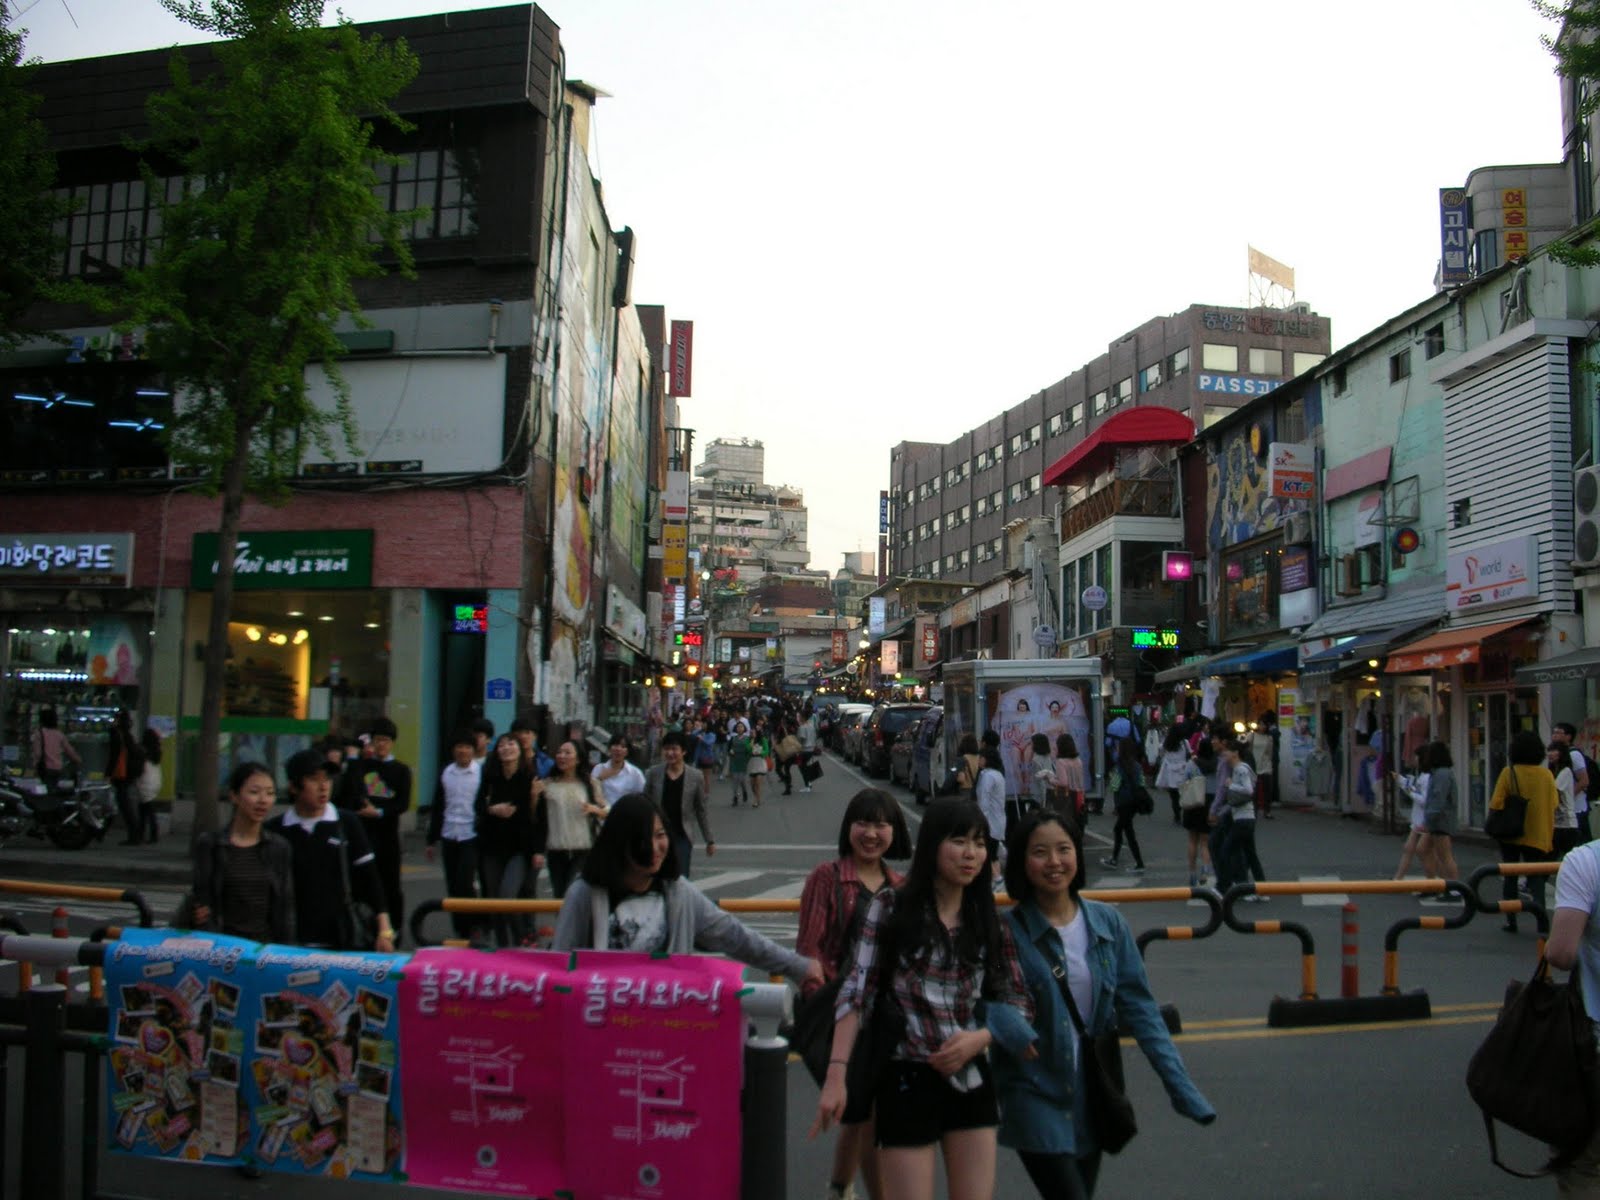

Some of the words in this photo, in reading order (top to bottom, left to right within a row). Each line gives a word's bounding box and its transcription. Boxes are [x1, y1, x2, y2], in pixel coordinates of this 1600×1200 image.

[1444, 211, 1464, 268] 고시텔
[1275, 457, 1287, 466] SK
[0, 540, 113, 572] 미화당레코드
[1479, 558, 1501, 577] world
[419, 964, 550, 1014] 놀러와~!
[582, 972, 722, 1025] 놀러와~!
